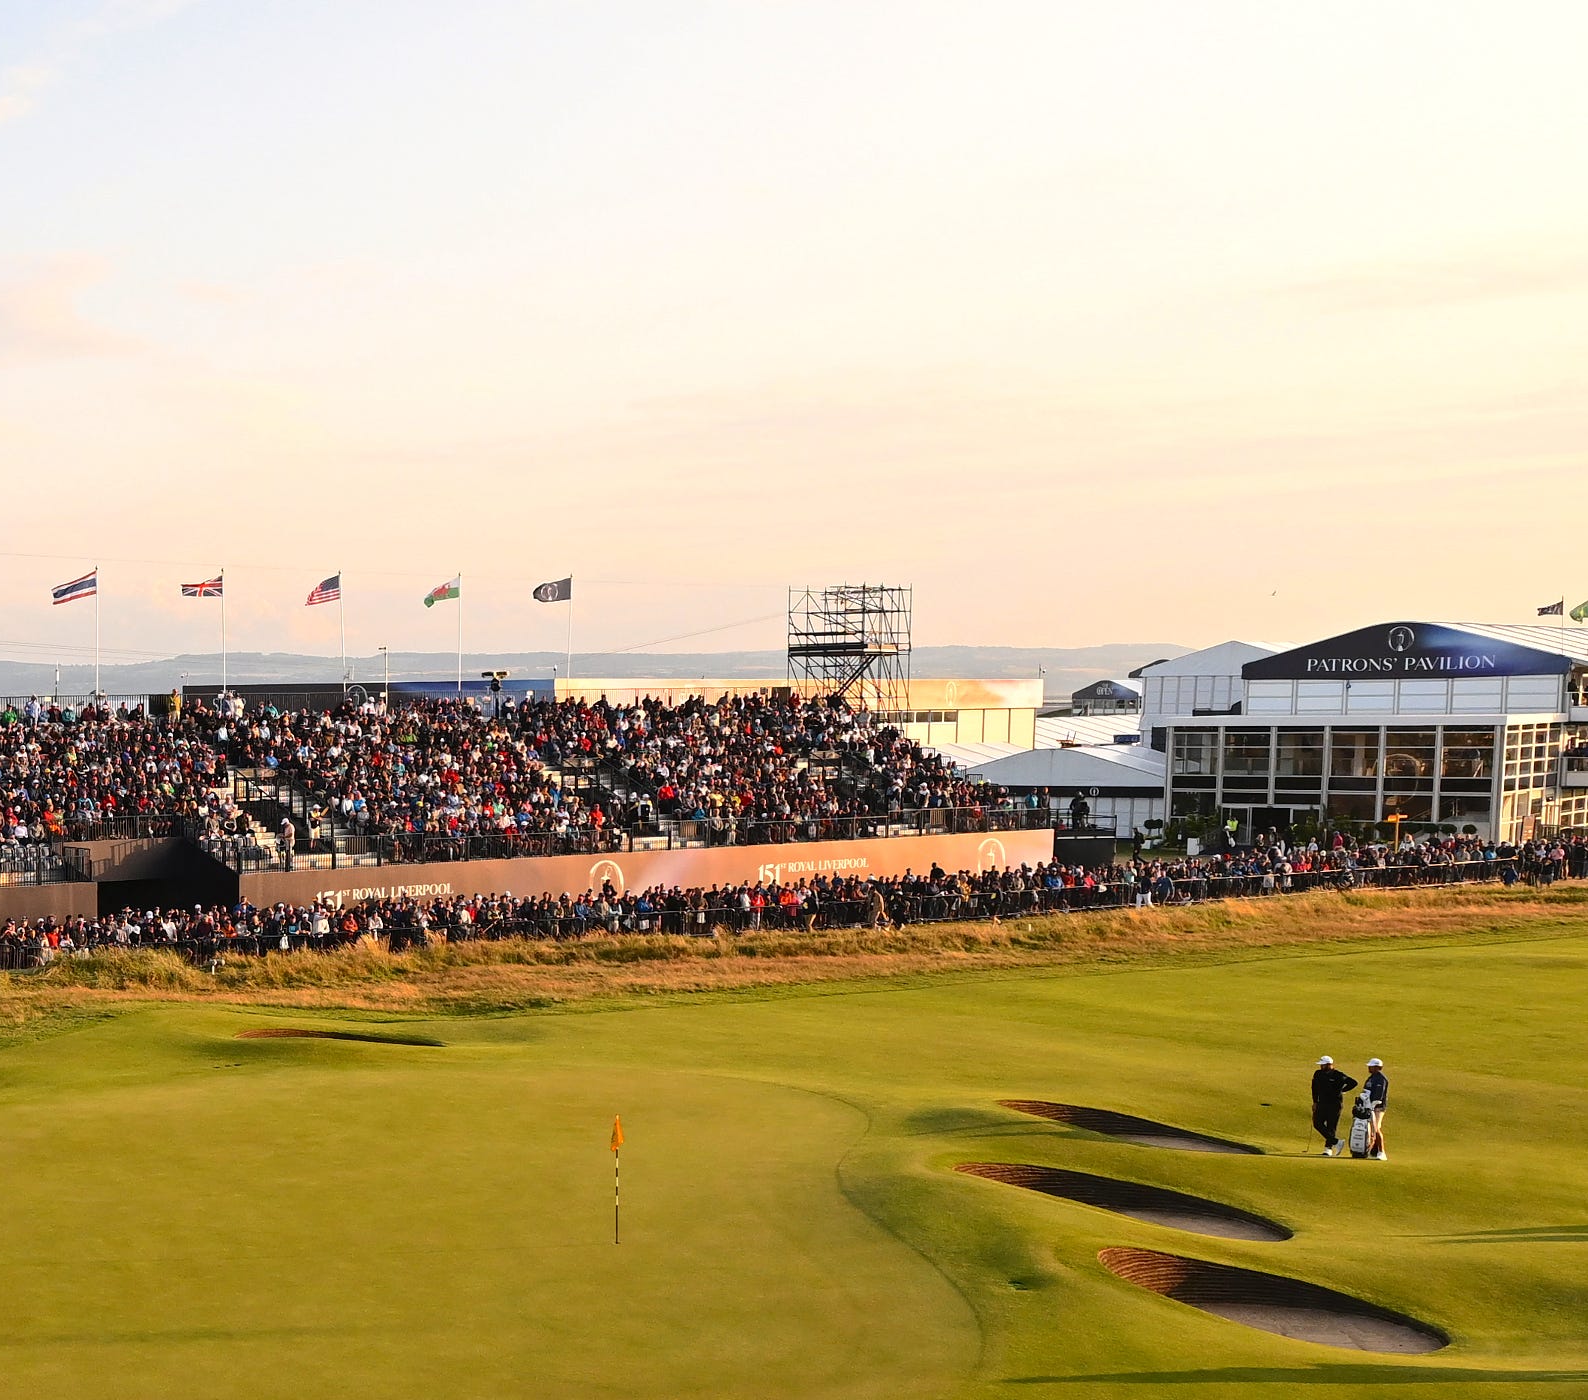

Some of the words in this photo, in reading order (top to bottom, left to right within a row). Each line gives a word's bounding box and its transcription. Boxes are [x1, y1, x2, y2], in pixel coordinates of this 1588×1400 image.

[1404, 655, 1496, 671] PAVILION
[788, 860, 817, 873] ROYAL
[818, 857, 869, 871] LIVERPOOL
[352, 886, 388, 900] ROYAL
[391, 882, 454, 898] LIVERPOOL
